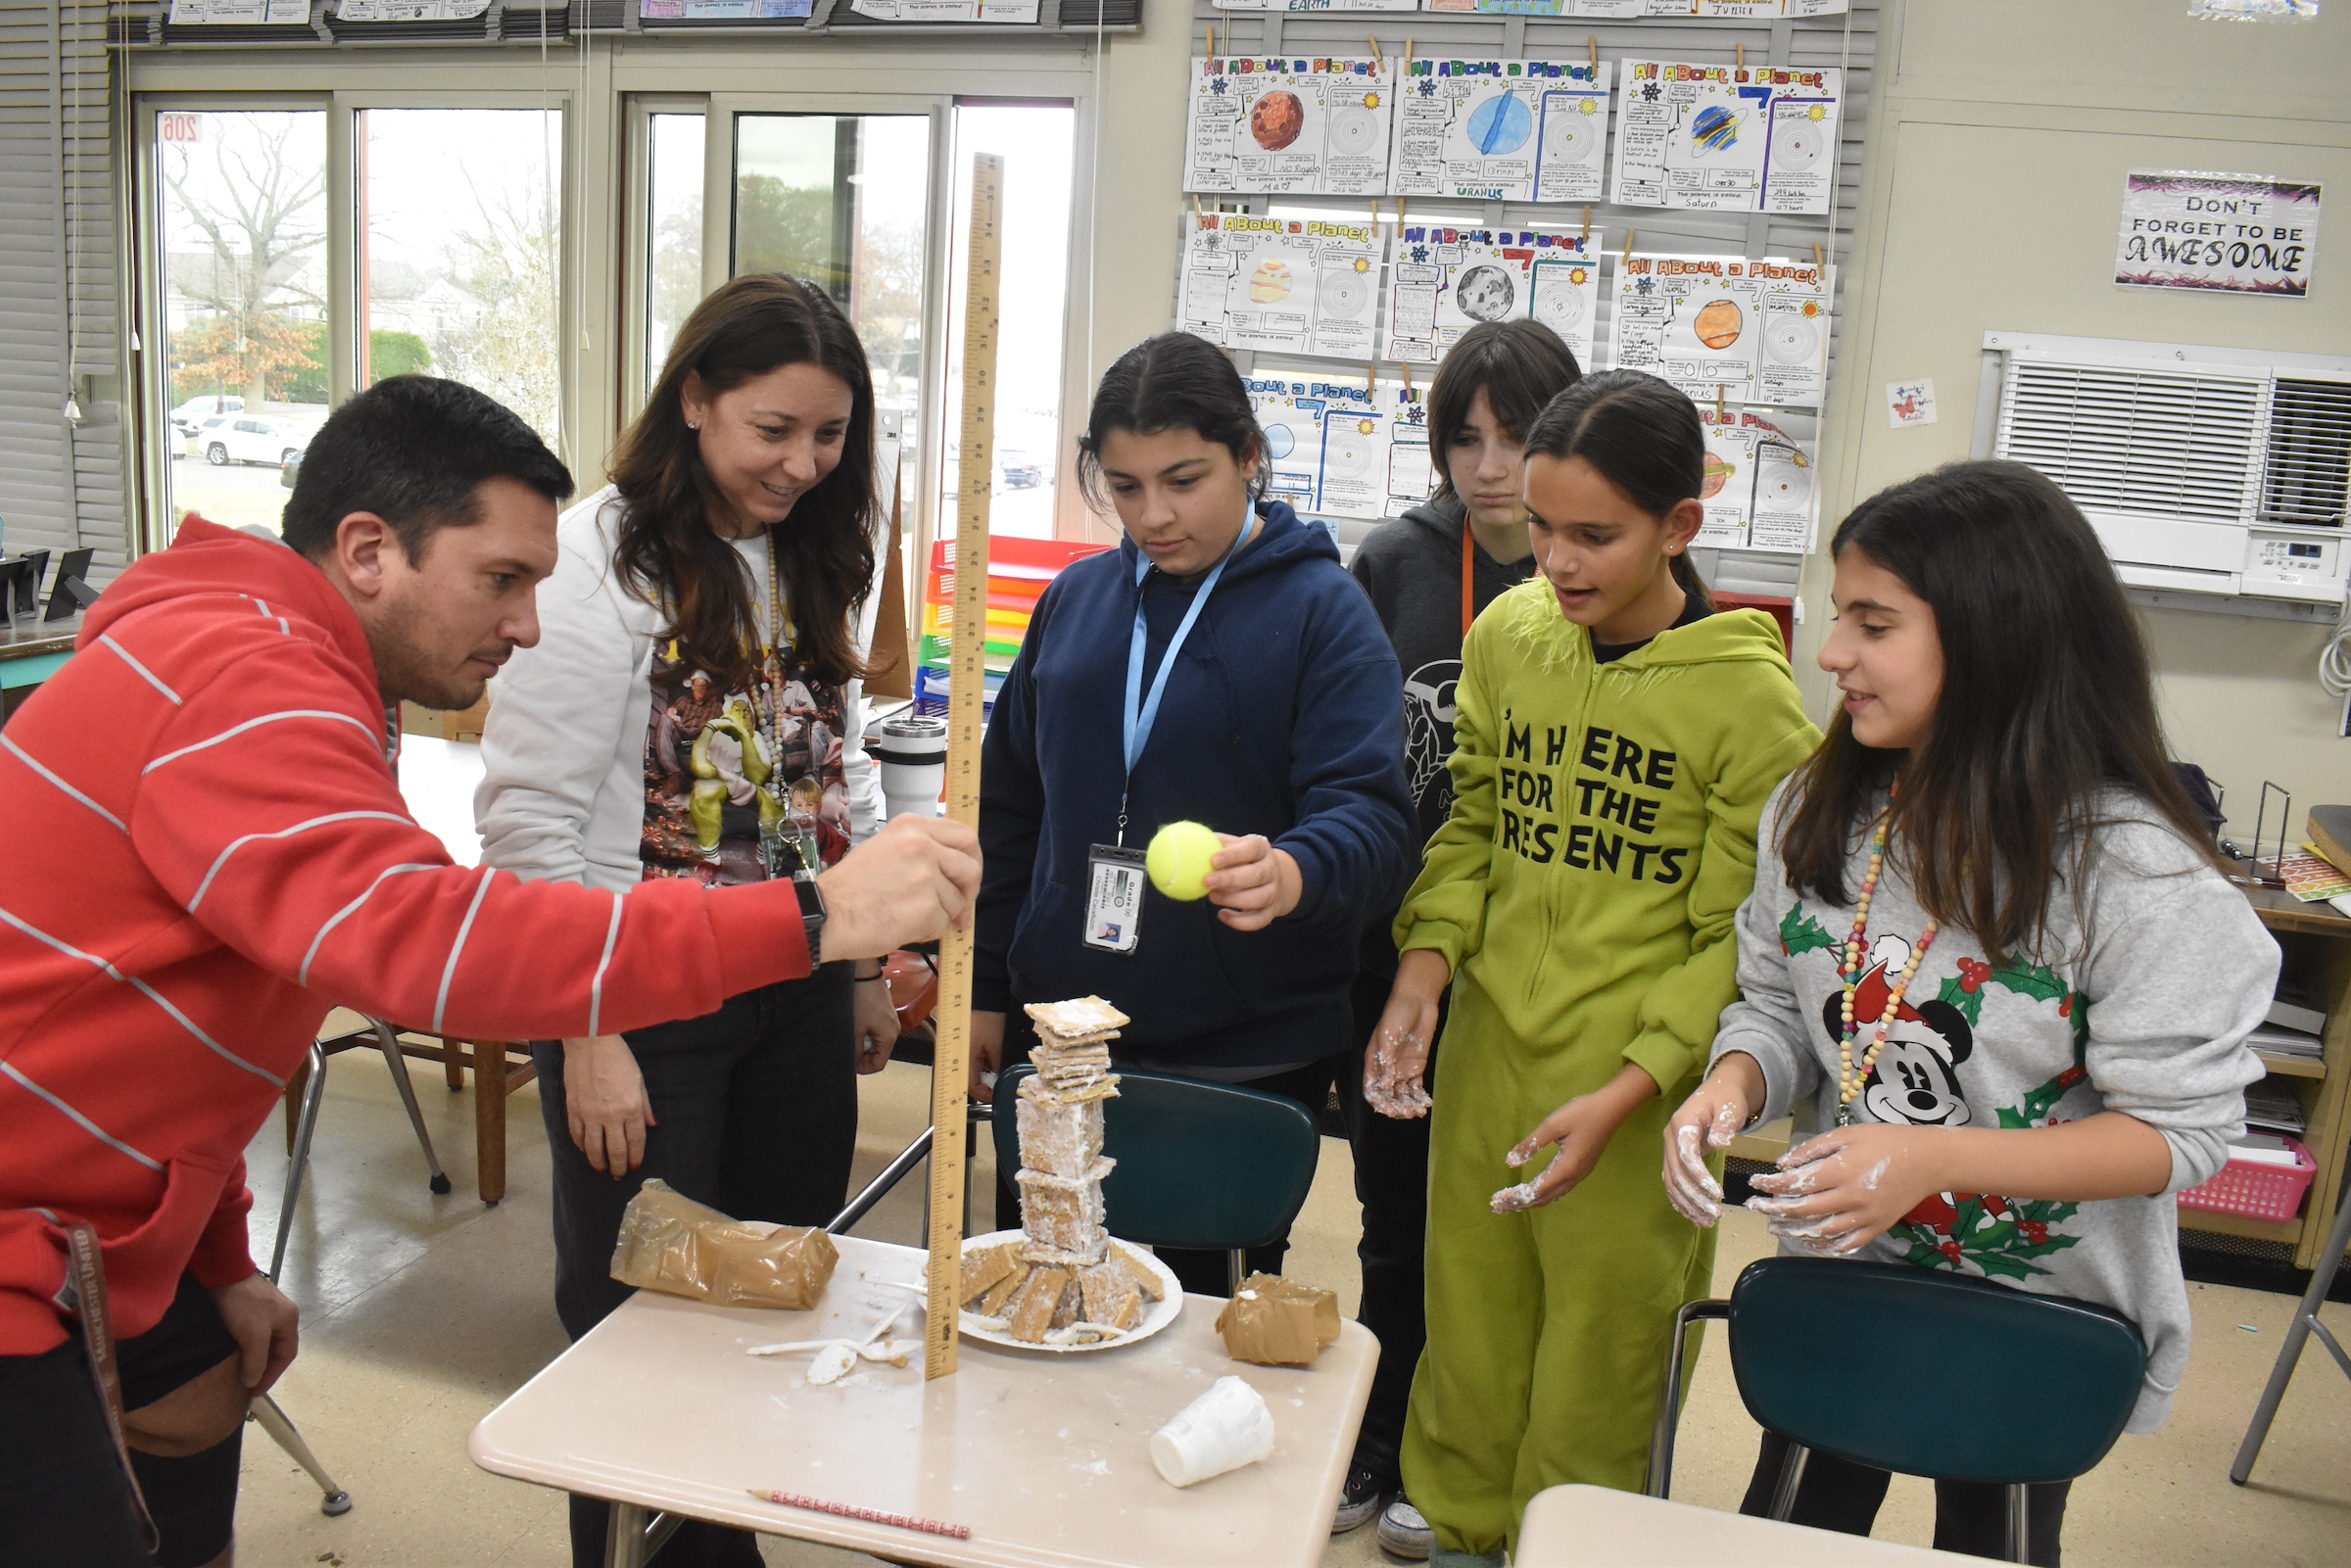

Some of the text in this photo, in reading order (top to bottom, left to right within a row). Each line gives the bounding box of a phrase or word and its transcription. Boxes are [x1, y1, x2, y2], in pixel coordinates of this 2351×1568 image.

[1289, 0, 1329, 11] EARTH
[1714, 6, 1753, 16] JUPITER
[1204, 59, 1223, 76] All
[1313, 58, 1376, 77] Planet
[1411, 60, 1433, 77] All
[1507, 63, 1521, 76] a
[1528, 62, 1595, 83] Planet
[1634, 63, 1658, 79] All
[1755, 68, 1823, 89] Planet
[987, 157, 996, 171] 36
[986, 184, 995, 201] 35
[1457, 187, 1504, 200] URANUS
[1686, 199, 1717, 208] Saturn
[984, 220, 993, 238] 34
[1200, 214, 1220, 230] All
[1288, 221, 1302, 233] a
[1307, 221, 1369, 243] Planet
[2133, 218, 2303, 242] FORGET TO BE
[1405, 227, 1425, 243] All
[1519, 231, 1585, 253] Planet
[2125, 235, 2305, 272] AWESOME
[984, 260, 991, 275] 33
[1628, 259, 1652, 275] All
[1728, 262, 1743, 275] a
[1750, 262, 1817, 285] Planet
[982, 297, 989, 312] 32
[980, 334, 988, 350] 31
[979, 370, 986, 386] 30
[1292, 383, 1305, 395] a
[1682, 388, 1711, 399] enus
[977, 406, 984, 422] 29
[975, 443, 983, 458] 28
[974, 479, 982, 495] 27
[972, 515, 980, 530] 26
[970, 550, 979, 566] 25
[969, 587, 977, 601] 24
[968, 622, 976, 637] 23
[966, 657, 974, 672] 22
[965, 692, 973, 706] 21
[963, 726, 972, 741] 20
[1545, 725, 1677, 790] HERE
[962, 759, 970, 774] 19
[961, 794, 969, 808] 18
[1501, 767, 1553, 813] FOR
[1575, 778, 1661, 834] THE
[1501, 808, 1689, 884] RESENTS
[955, 961, 963, 974] 13
[954, 994, 962, 1008] 12
[952, 1026, 961, 1040] 11
[951, 1059, 959, 1072] 10
